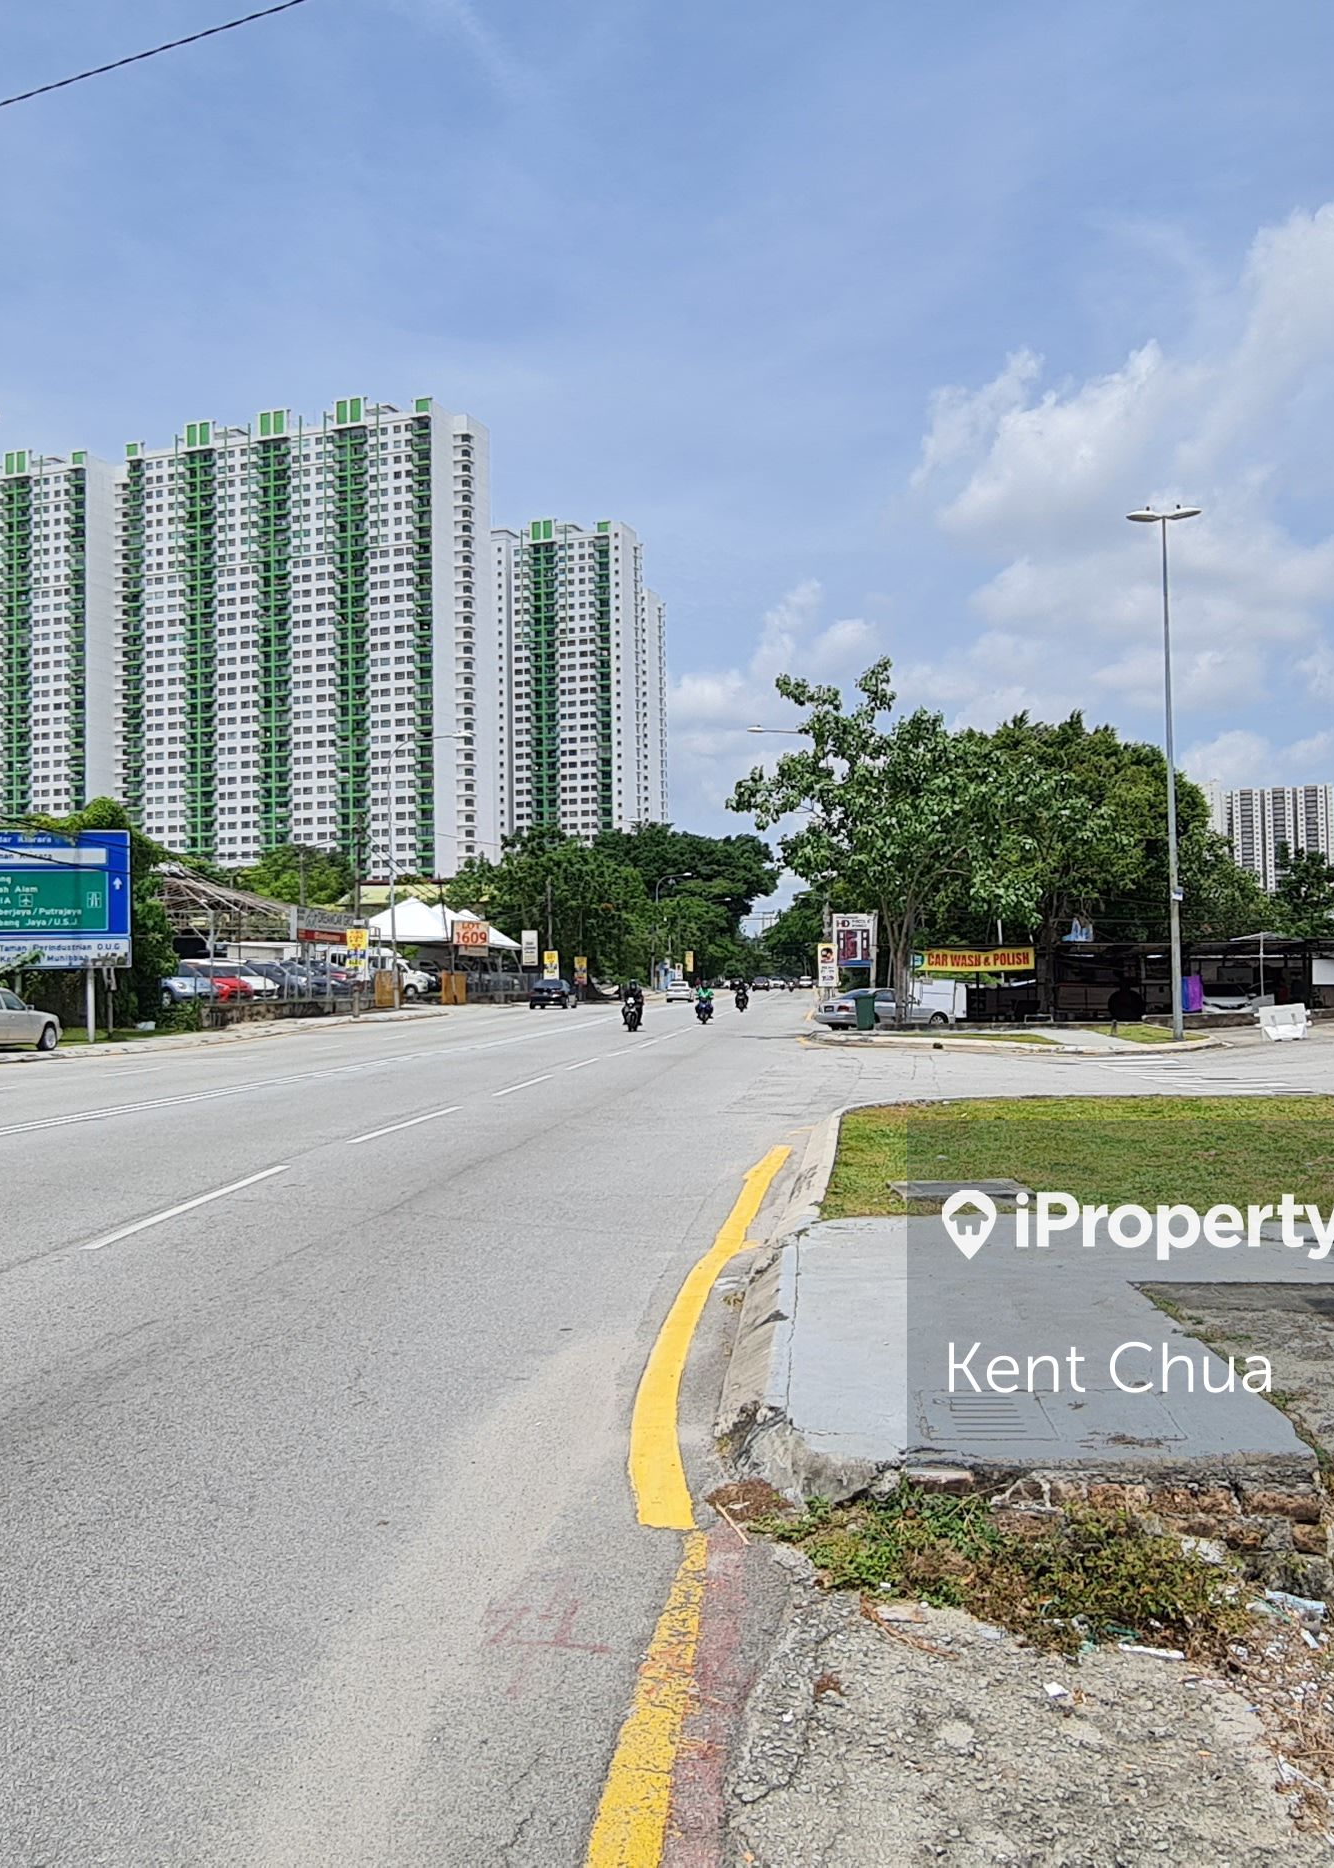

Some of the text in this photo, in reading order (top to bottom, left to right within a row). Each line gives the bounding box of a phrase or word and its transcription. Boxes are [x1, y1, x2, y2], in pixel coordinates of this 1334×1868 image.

[14, 885, 38, 894] Alam
[461, 921, 482, 930] LOT
[455, 931, 488, 945] 1609
[0, 944, 27, 952] Taman
[927, 953, 948, 967] CAR
[950, 953, 981, 967] WASH
[983, 956, 991, 967] &
[993, 952, 1030, 967] POLISH
